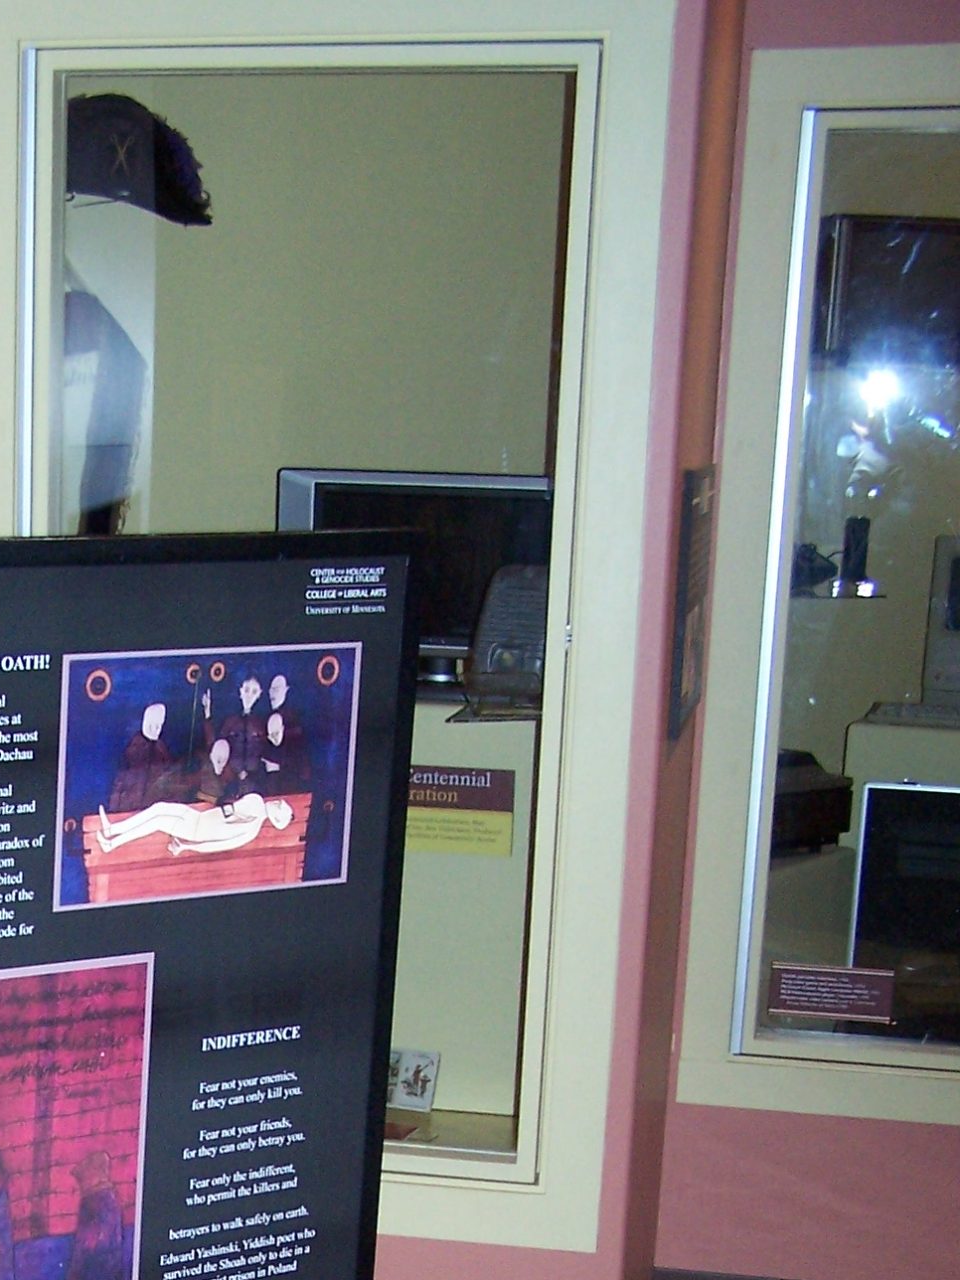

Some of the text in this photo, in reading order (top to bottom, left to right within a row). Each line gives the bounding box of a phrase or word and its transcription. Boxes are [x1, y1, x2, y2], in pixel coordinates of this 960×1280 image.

[1, 655, 50, 671] OATH!
[11, 714, 21, 725] at
[13, 731, 38, 742] most
[409, 786, 458, 802] ration
[17, 800, 36, 813] and
[32, 834, 45, 847] of
[5, 889, 16, 902] of
[16, 889, 34, 901] the
[19, 923, 34, 935] for
[202, 1026, 300, 1051] INDIFFERENCE
[200, 1082, 220, 1093] Fear
[221, 1080, 236, 1090] not
[237, 1077, 258, 1091] your
[192, 1099, 206, 1110] for
[207, 1097, 226, 1109] they
[228, 1095, 244, 1105] can
[246, 1090, 265, 1103] only
[267, 1087, 282, 1098] kill
[200, 1130, 220, 1141] Fear
[221, 1127, 236, 1137] not
[237, 1125, 258, 1137] your
[183, 1148, 196, 1159] for
[198, 1146, 217, 1157] they
[219, 1144, 235, 1153] can
[237, 1138, 256, 1151] only
[258, 1136, 285, 1147] betray
[190, 1179, 210, 1190] Fear
[211, 1174, 231, 1186] only
[233, 1171, 247, 1182] the
[186, 1177, 297, 1205] who permit the killers and
[169, 1226, 209, 1240] betrayers
[212, 1224, 221, 1232] to
[222, 1217, 243, 1230] walk
[245, 1213, 271, 1226] safely
[273, 1212, 284, 1221] on
[160, 1249, 195, 1265] Edward
[277, 1233, 295, 1246] poet
[297, 1228, 315, 1239] who
[163, 1264, 202, 1280] survived
[204, 1262, 218, 1273] the
[248, 1252, 267, 1264] only
[269, 1252, 278, 1260] to
[279, 1247, 293, 1258] die
[294, 1245, 303, 1255] in
[257, 1267, 266, 1277] in
[268, 1260, 297, 1275] Poland
